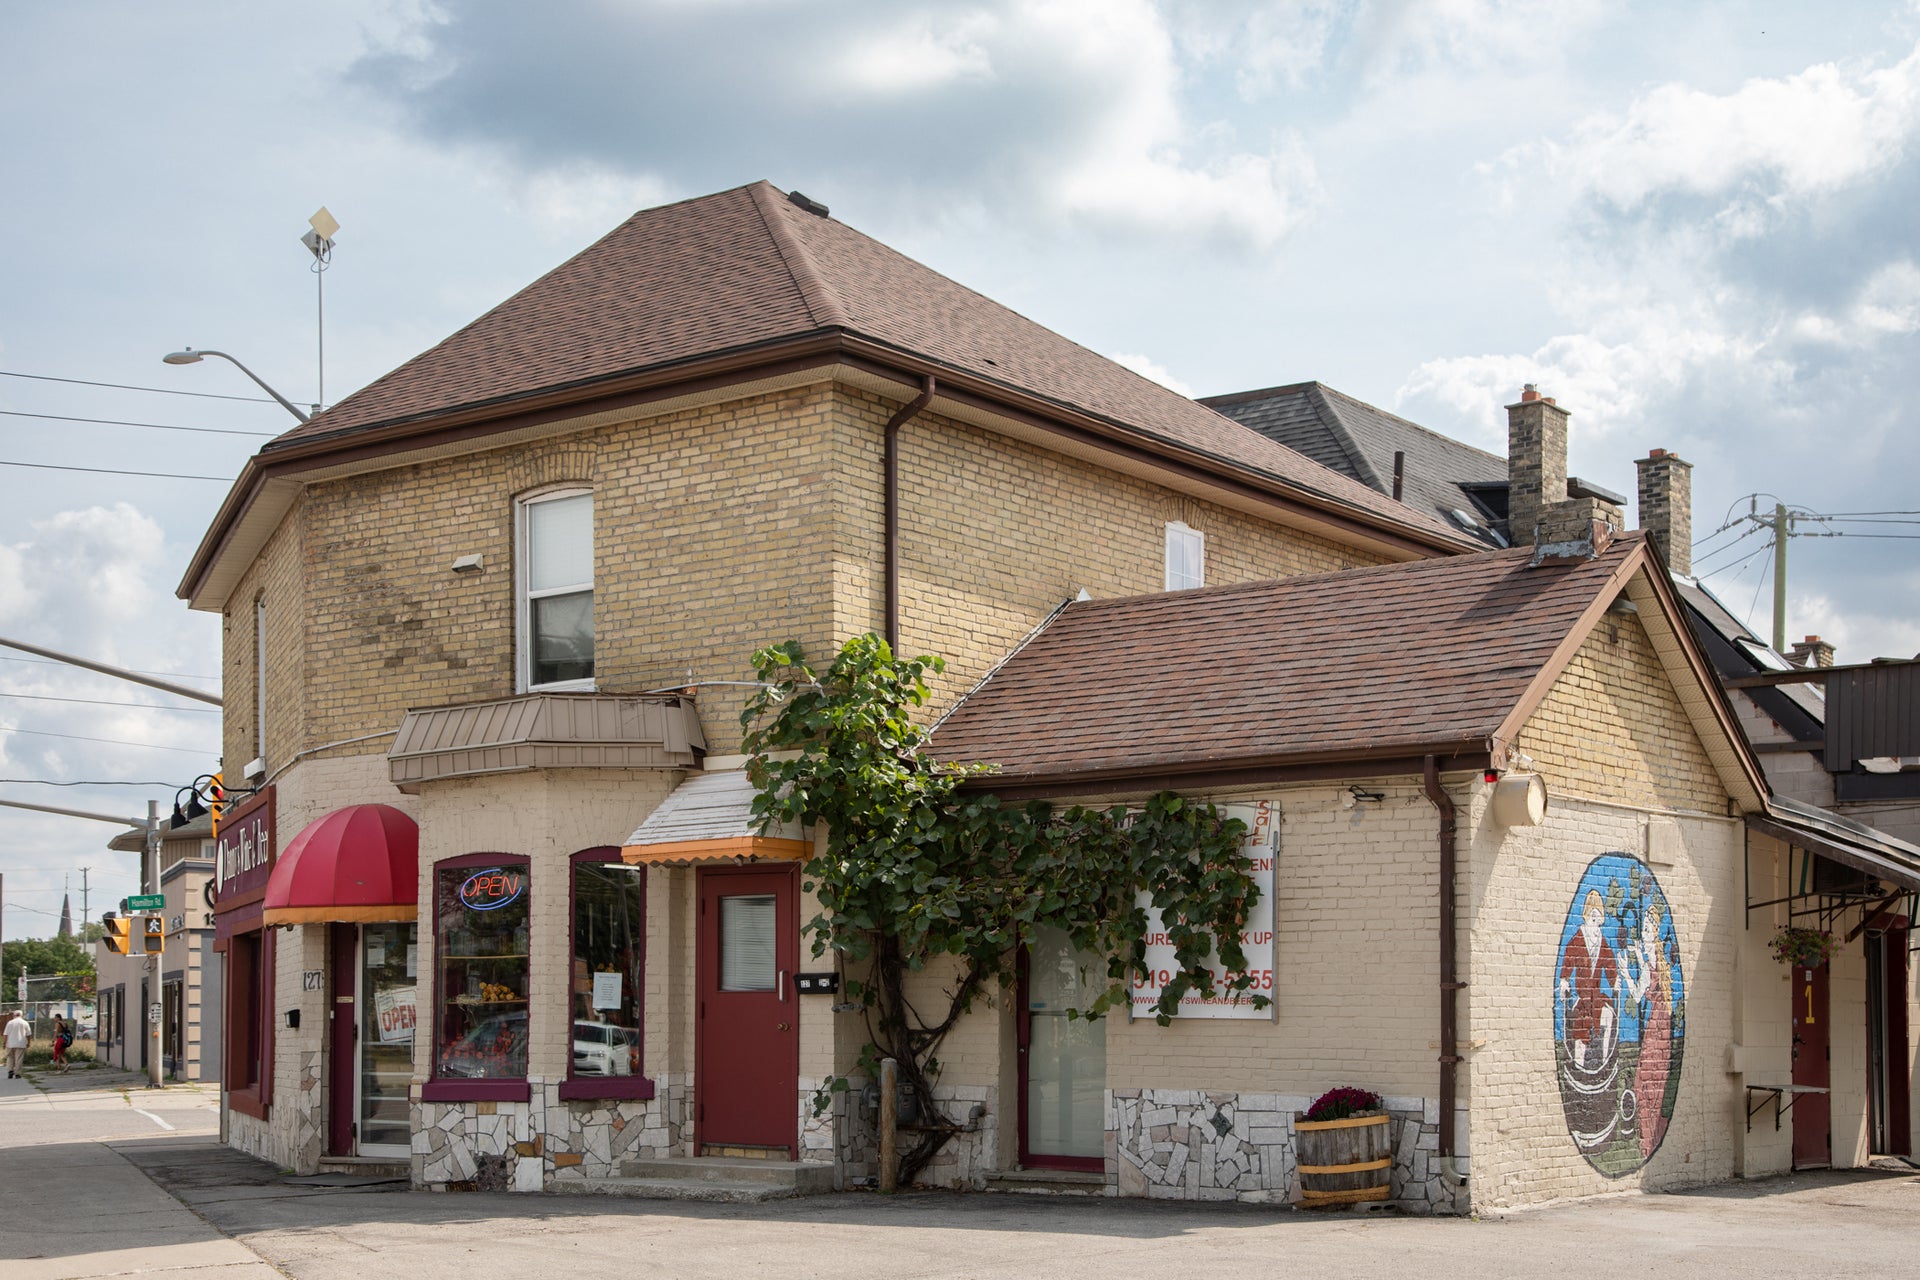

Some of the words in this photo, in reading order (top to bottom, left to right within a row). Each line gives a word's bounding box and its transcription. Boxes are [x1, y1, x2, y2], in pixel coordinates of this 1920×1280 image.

[463, 874, 519, 897] OPEN
[1254, 931, 1273, 945] UP
[1804, 984, 1815, 1024] 1
[381, 1004, 417, 1032] OPEN
